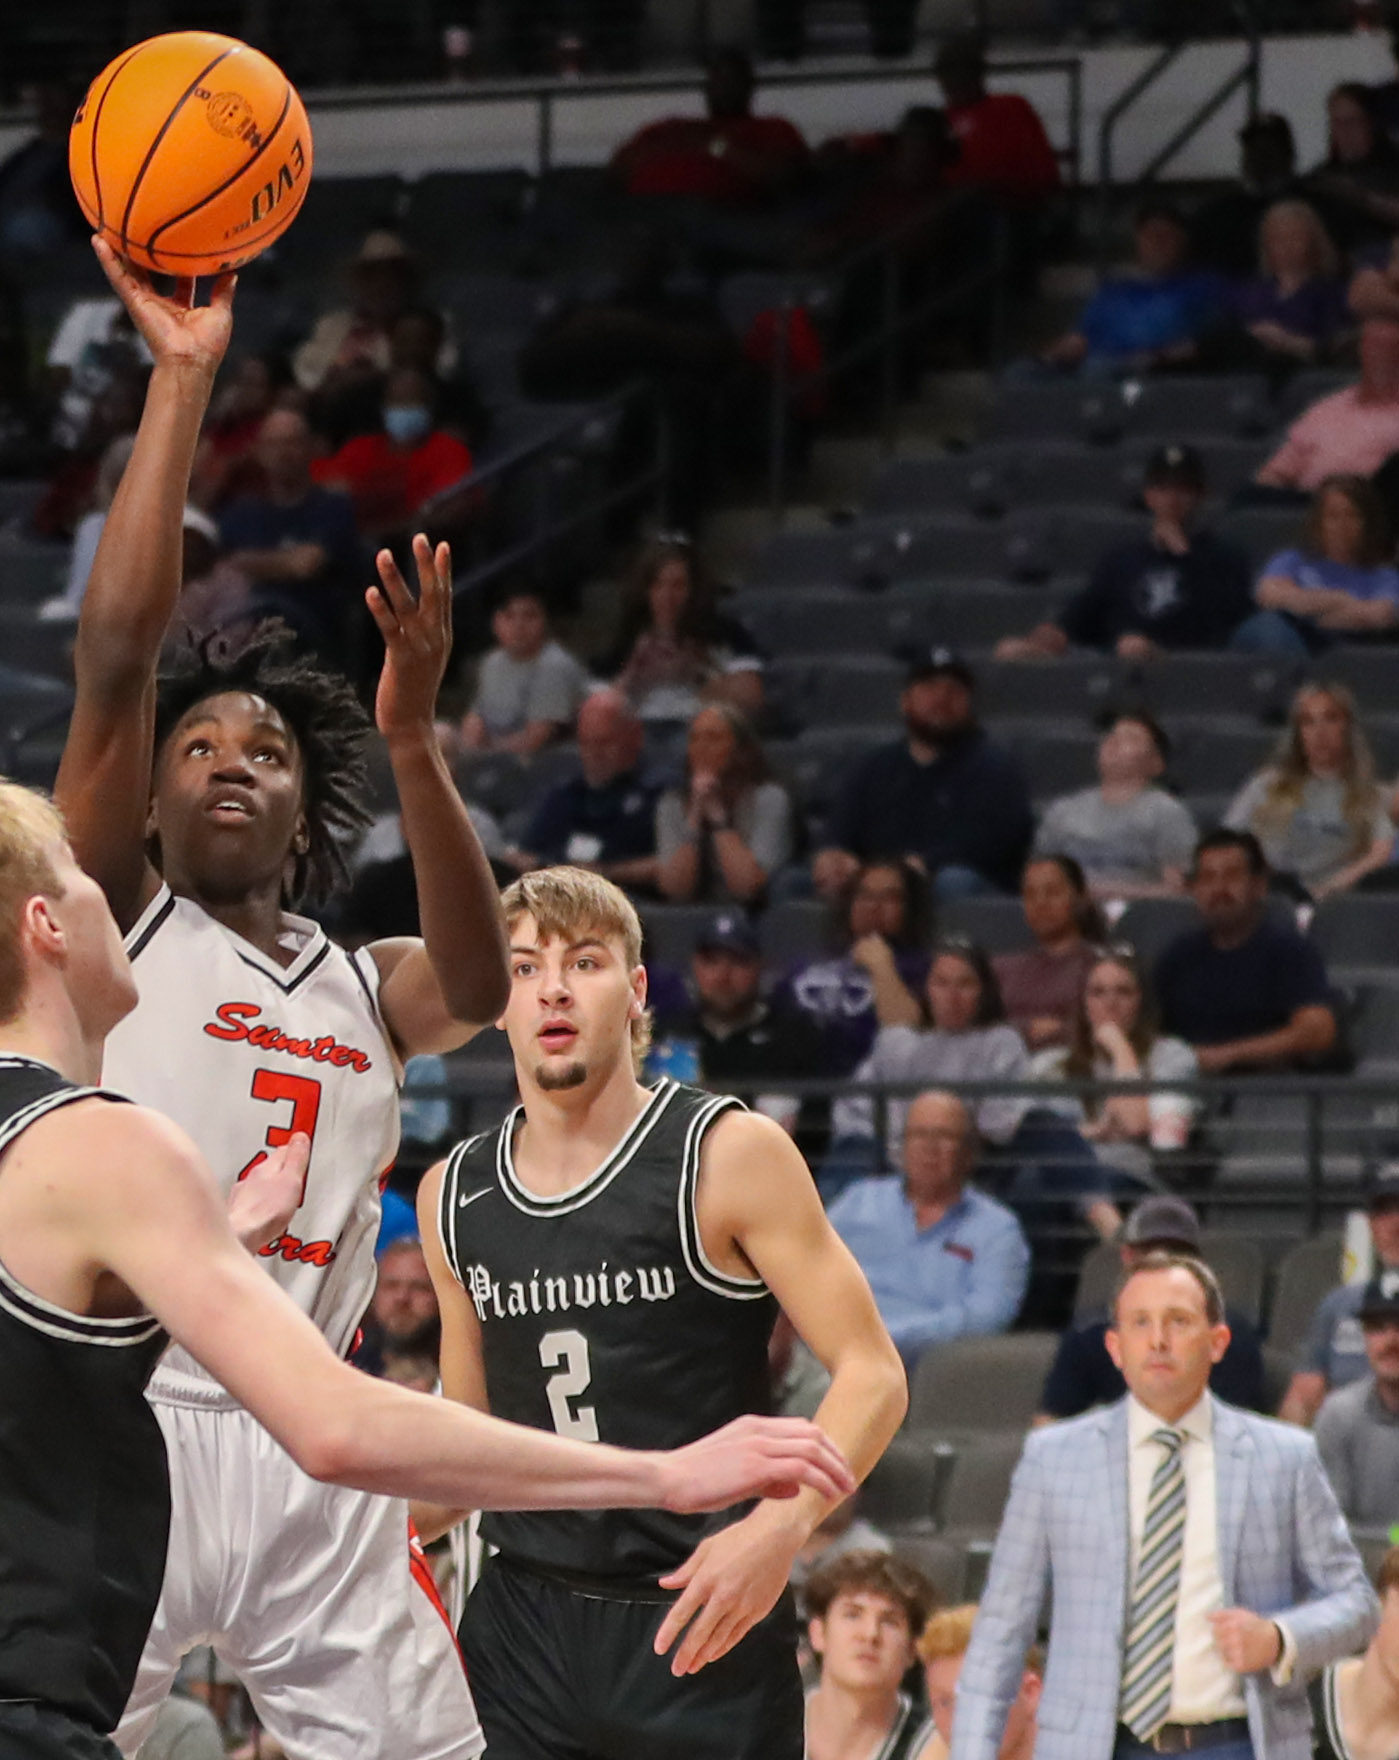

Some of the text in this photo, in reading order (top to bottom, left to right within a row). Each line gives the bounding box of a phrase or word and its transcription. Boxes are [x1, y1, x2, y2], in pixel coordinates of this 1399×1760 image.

[203, 1002, 372, 1073] Sumter
[238, 1068, 322, 1209] 3
[466, 1262, 676, 1321] Plainview
[538, 1329, 599, 1442] 2
